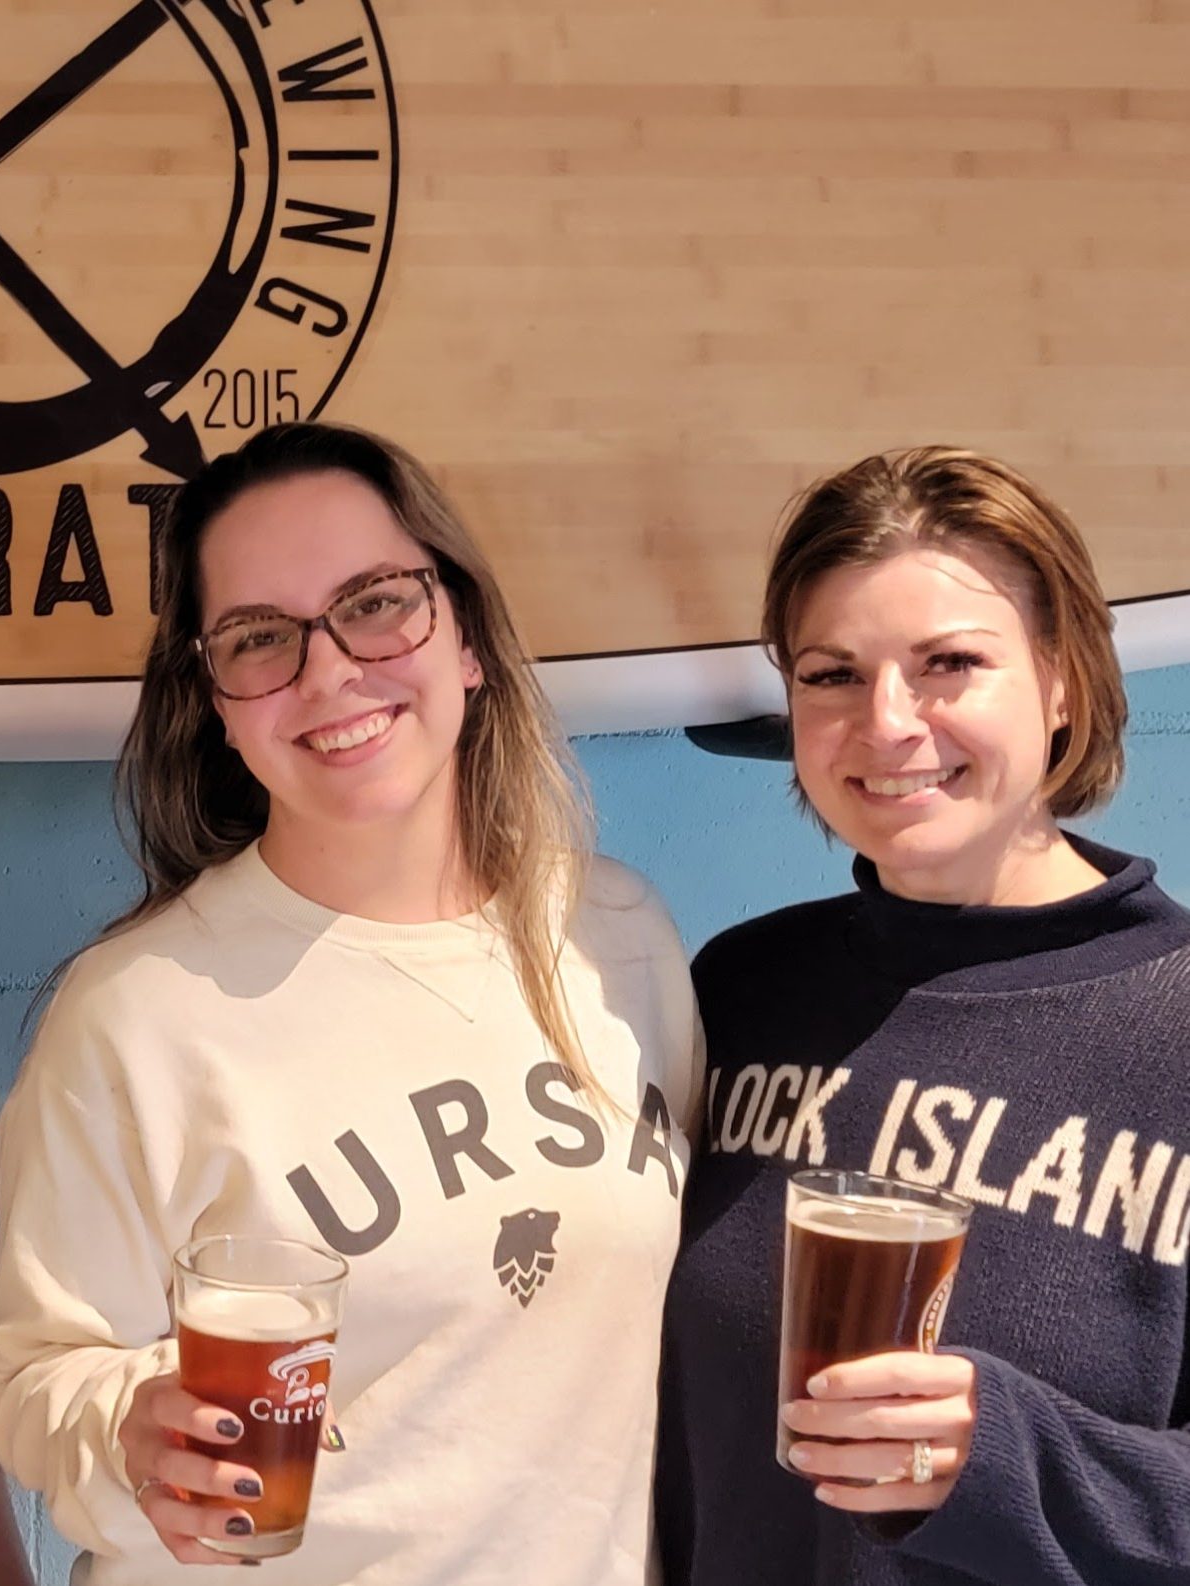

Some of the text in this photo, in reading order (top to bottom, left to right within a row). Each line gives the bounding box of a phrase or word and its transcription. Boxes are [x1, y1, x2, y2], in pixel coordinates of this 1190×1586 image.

[203, 368, 300, 430] 2015
[285, 1060, 679, 1257] URSA
[249, 1397, 326, 1425] Curio
